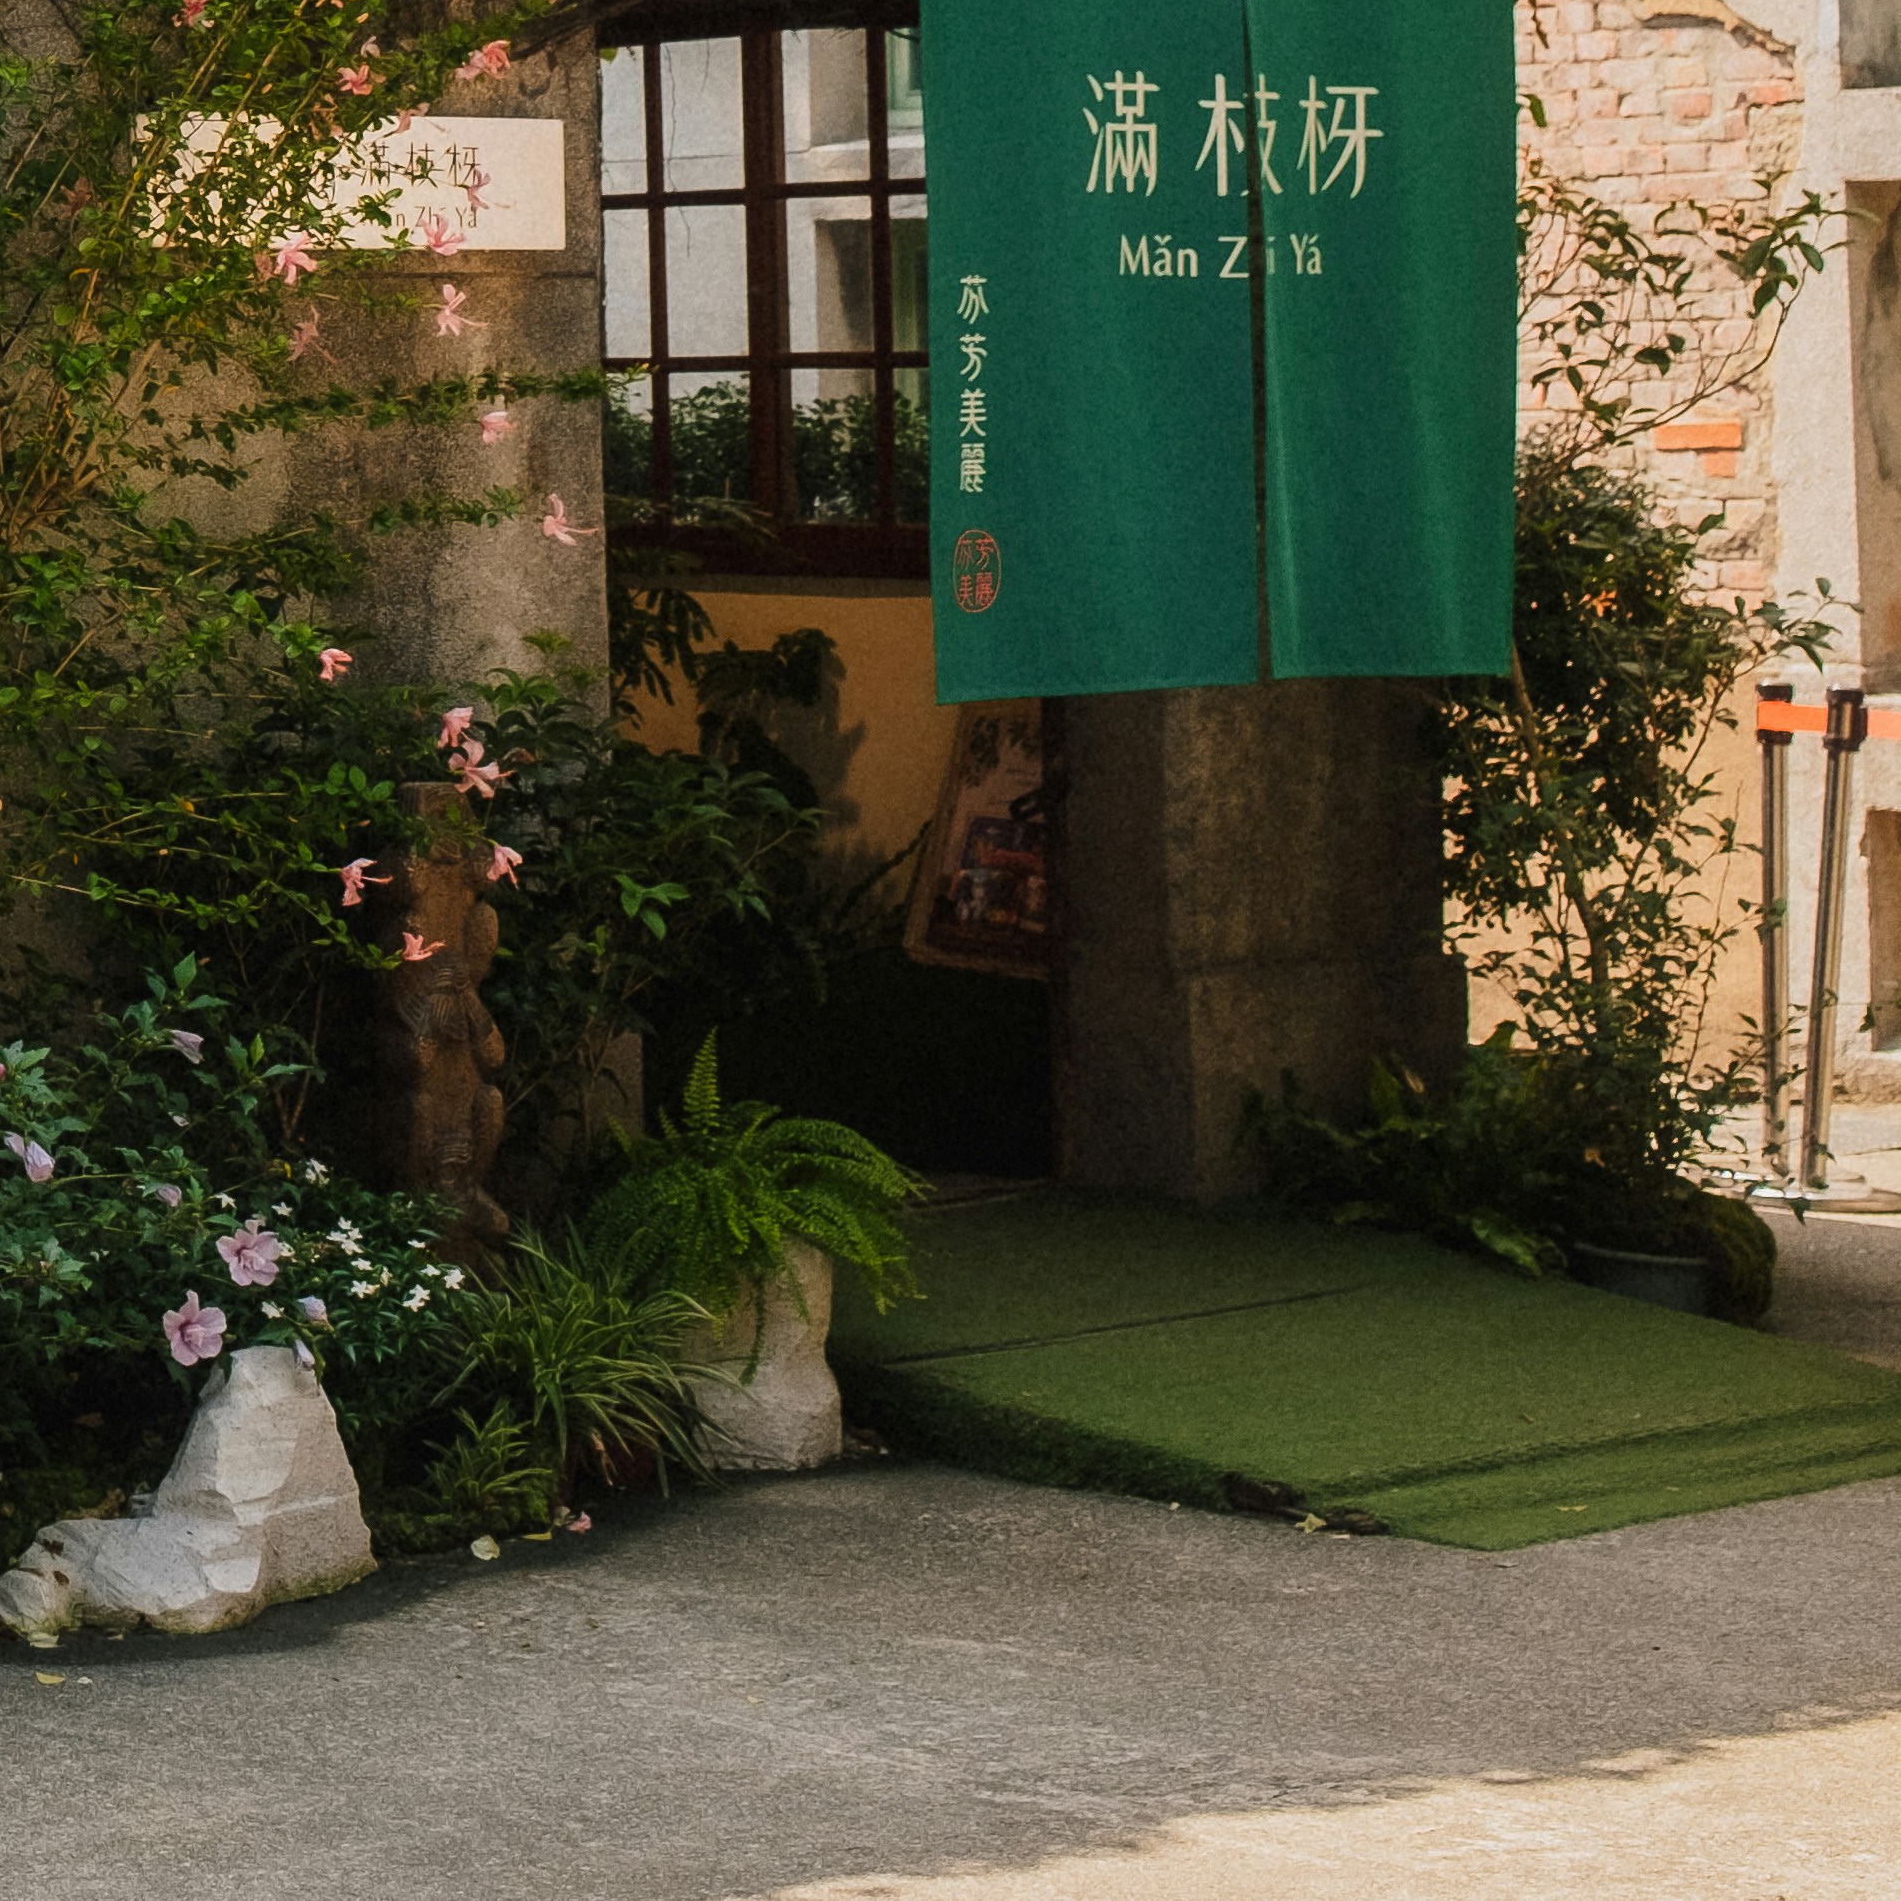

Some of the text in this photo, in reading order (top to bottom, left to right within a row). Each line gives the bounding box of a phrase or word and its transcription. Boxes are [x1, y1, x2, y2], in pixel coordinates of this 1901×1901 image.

[1082, 70, 1385, 199] 滿枝枒
[1289, 234, 1322, 275] Yá
